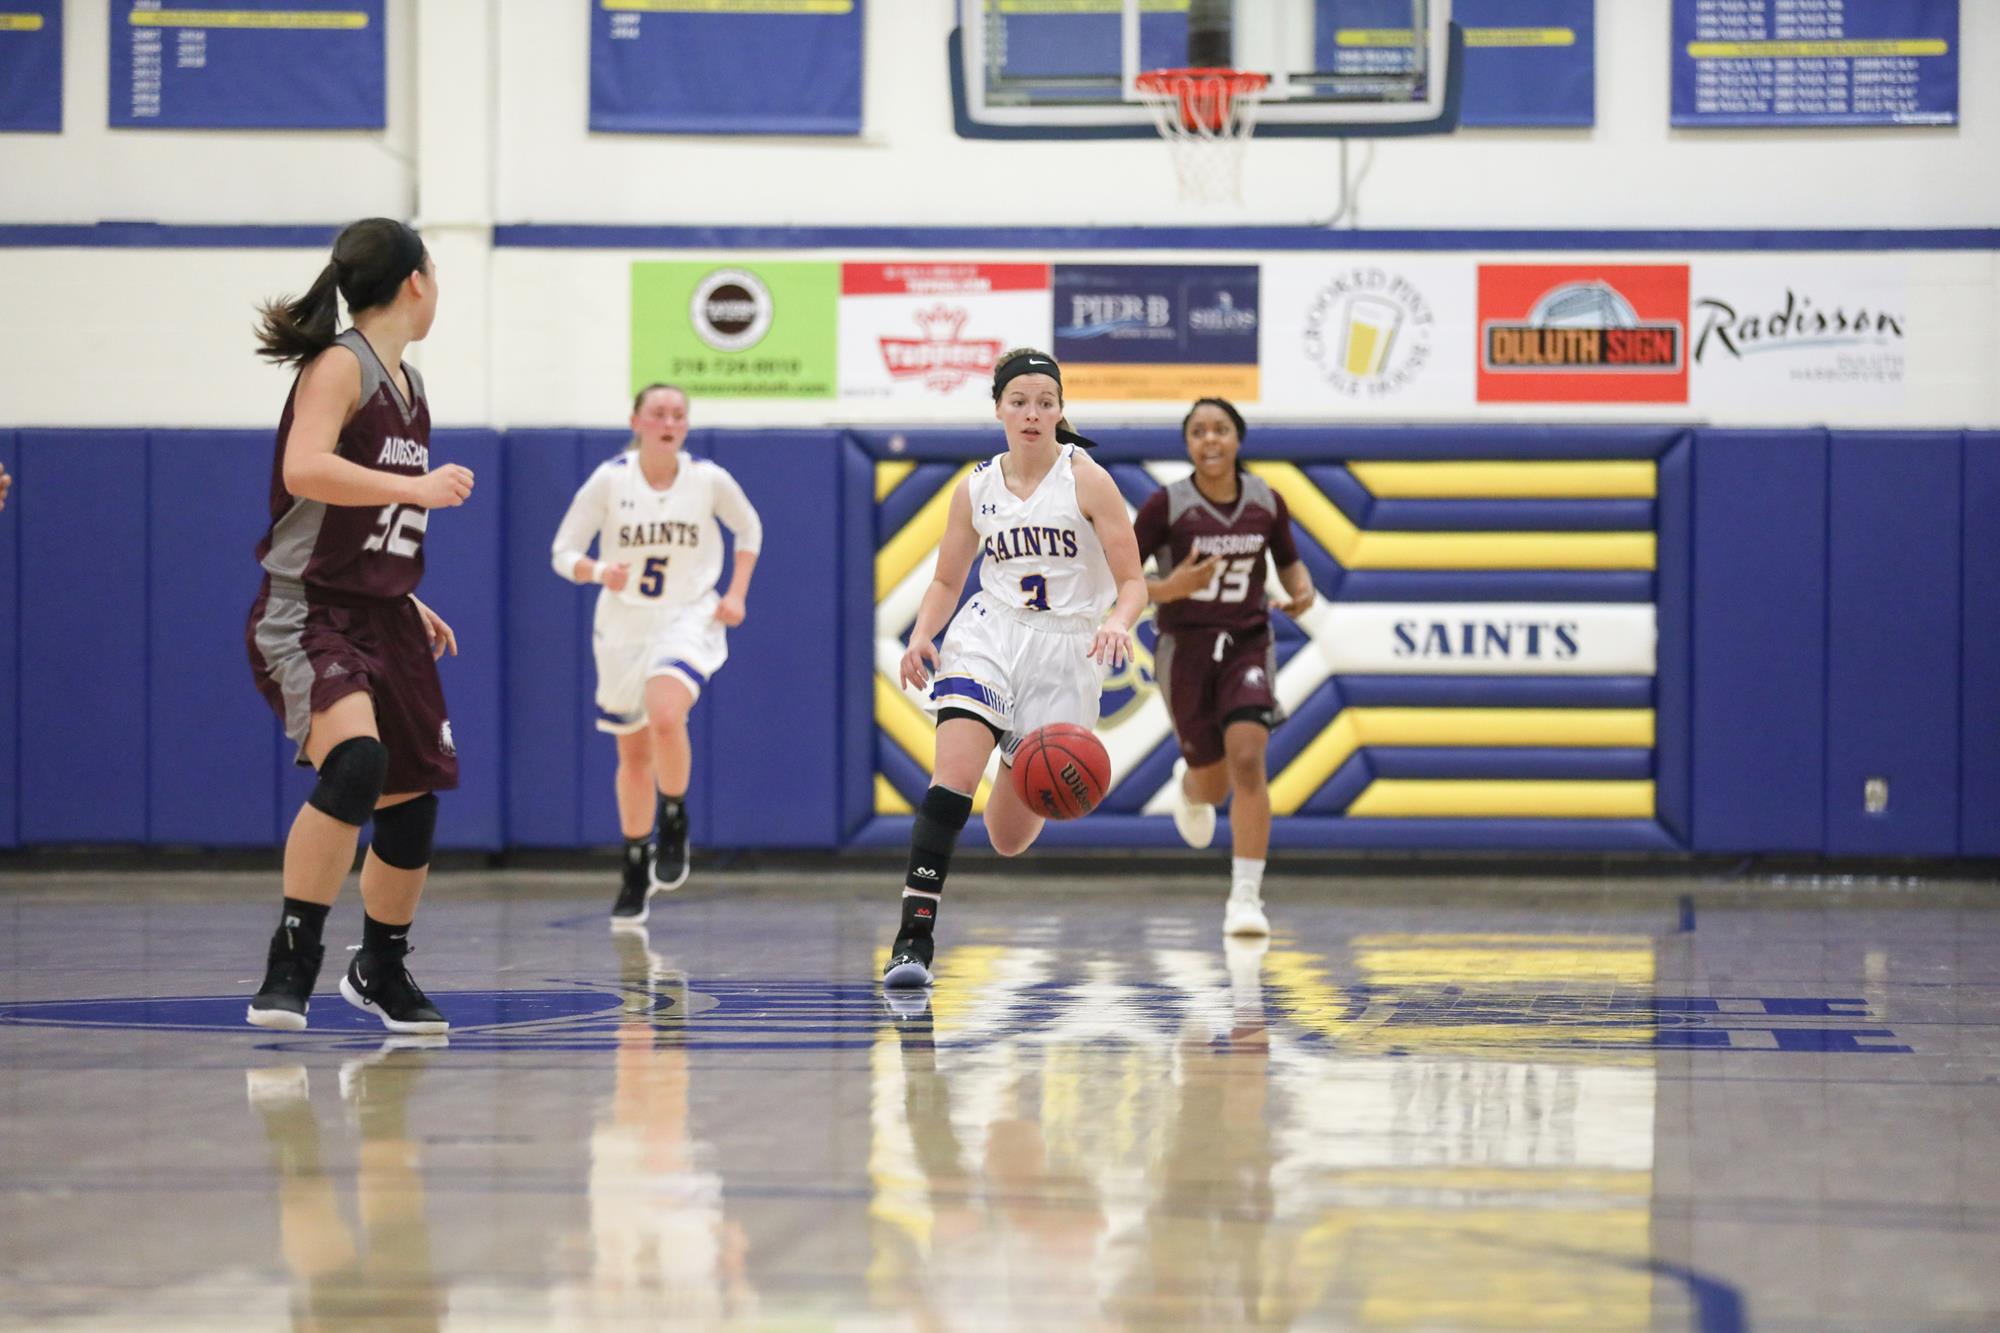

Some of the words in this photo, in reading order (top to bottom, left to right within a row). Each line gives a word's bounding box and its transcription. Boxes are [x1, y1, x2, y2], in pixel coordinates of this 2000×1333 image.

[1072, 294, 1145, 329] PIER
[1146, 294, 1171, 328] B
[1694, 286, 1903, 365] Radisson
[1493, 329, 1598, 365] DULUTH
[1606, 329, 1674, 365] SIGN
[619, 521, 699, 547] SAINTS
[985, 526, 1078, 563] SAINTS
[640, 555, 670, 598] 5
[1393, 620, 1579, 658] SAINTS
